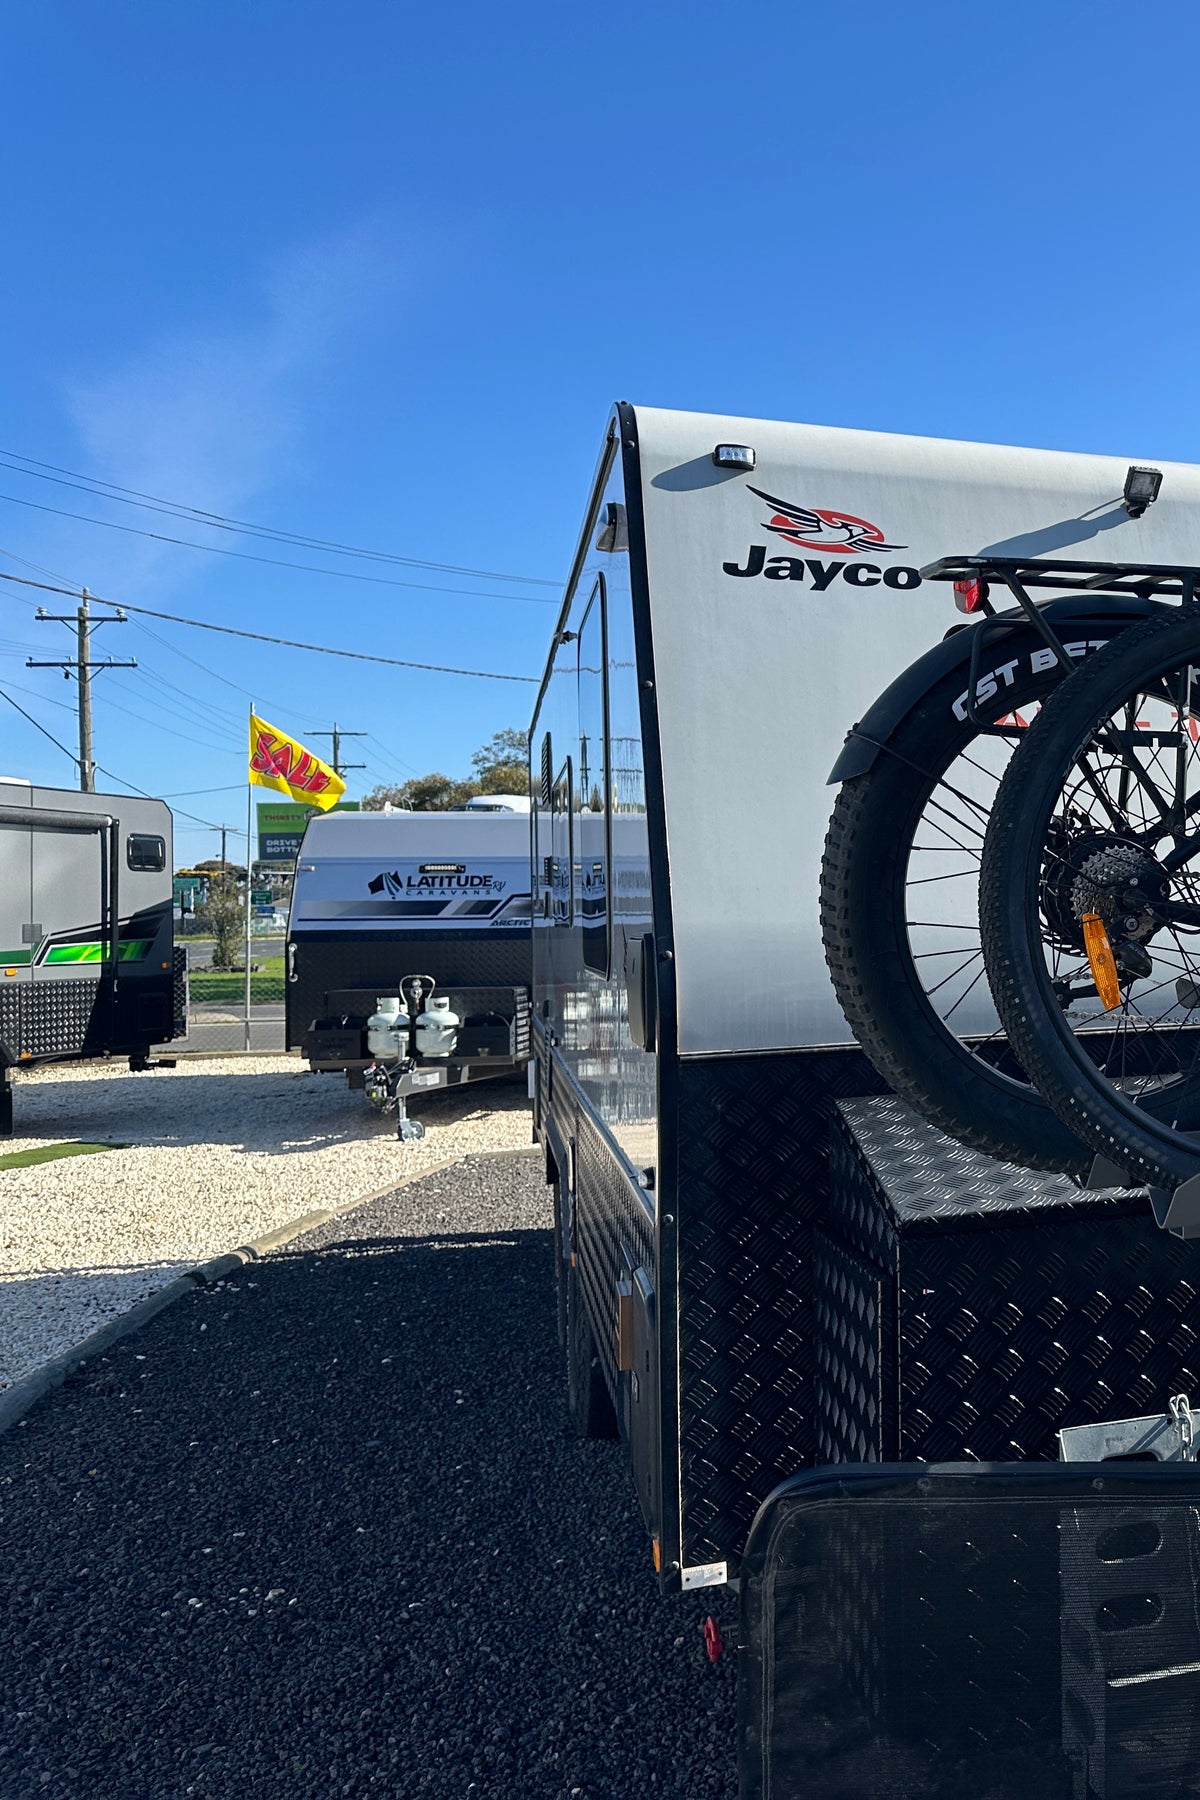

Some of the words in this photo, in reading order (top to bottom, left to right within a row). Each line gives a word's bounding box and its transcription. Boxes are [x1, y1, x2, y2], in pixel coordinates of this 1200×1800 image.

[722, 545, 923, 592] Jayco
[250, 732, 331, 793] SALE
[406, 875, 493, 888] LATITUDE
[490, 919, 531, 927] ARCTIC
